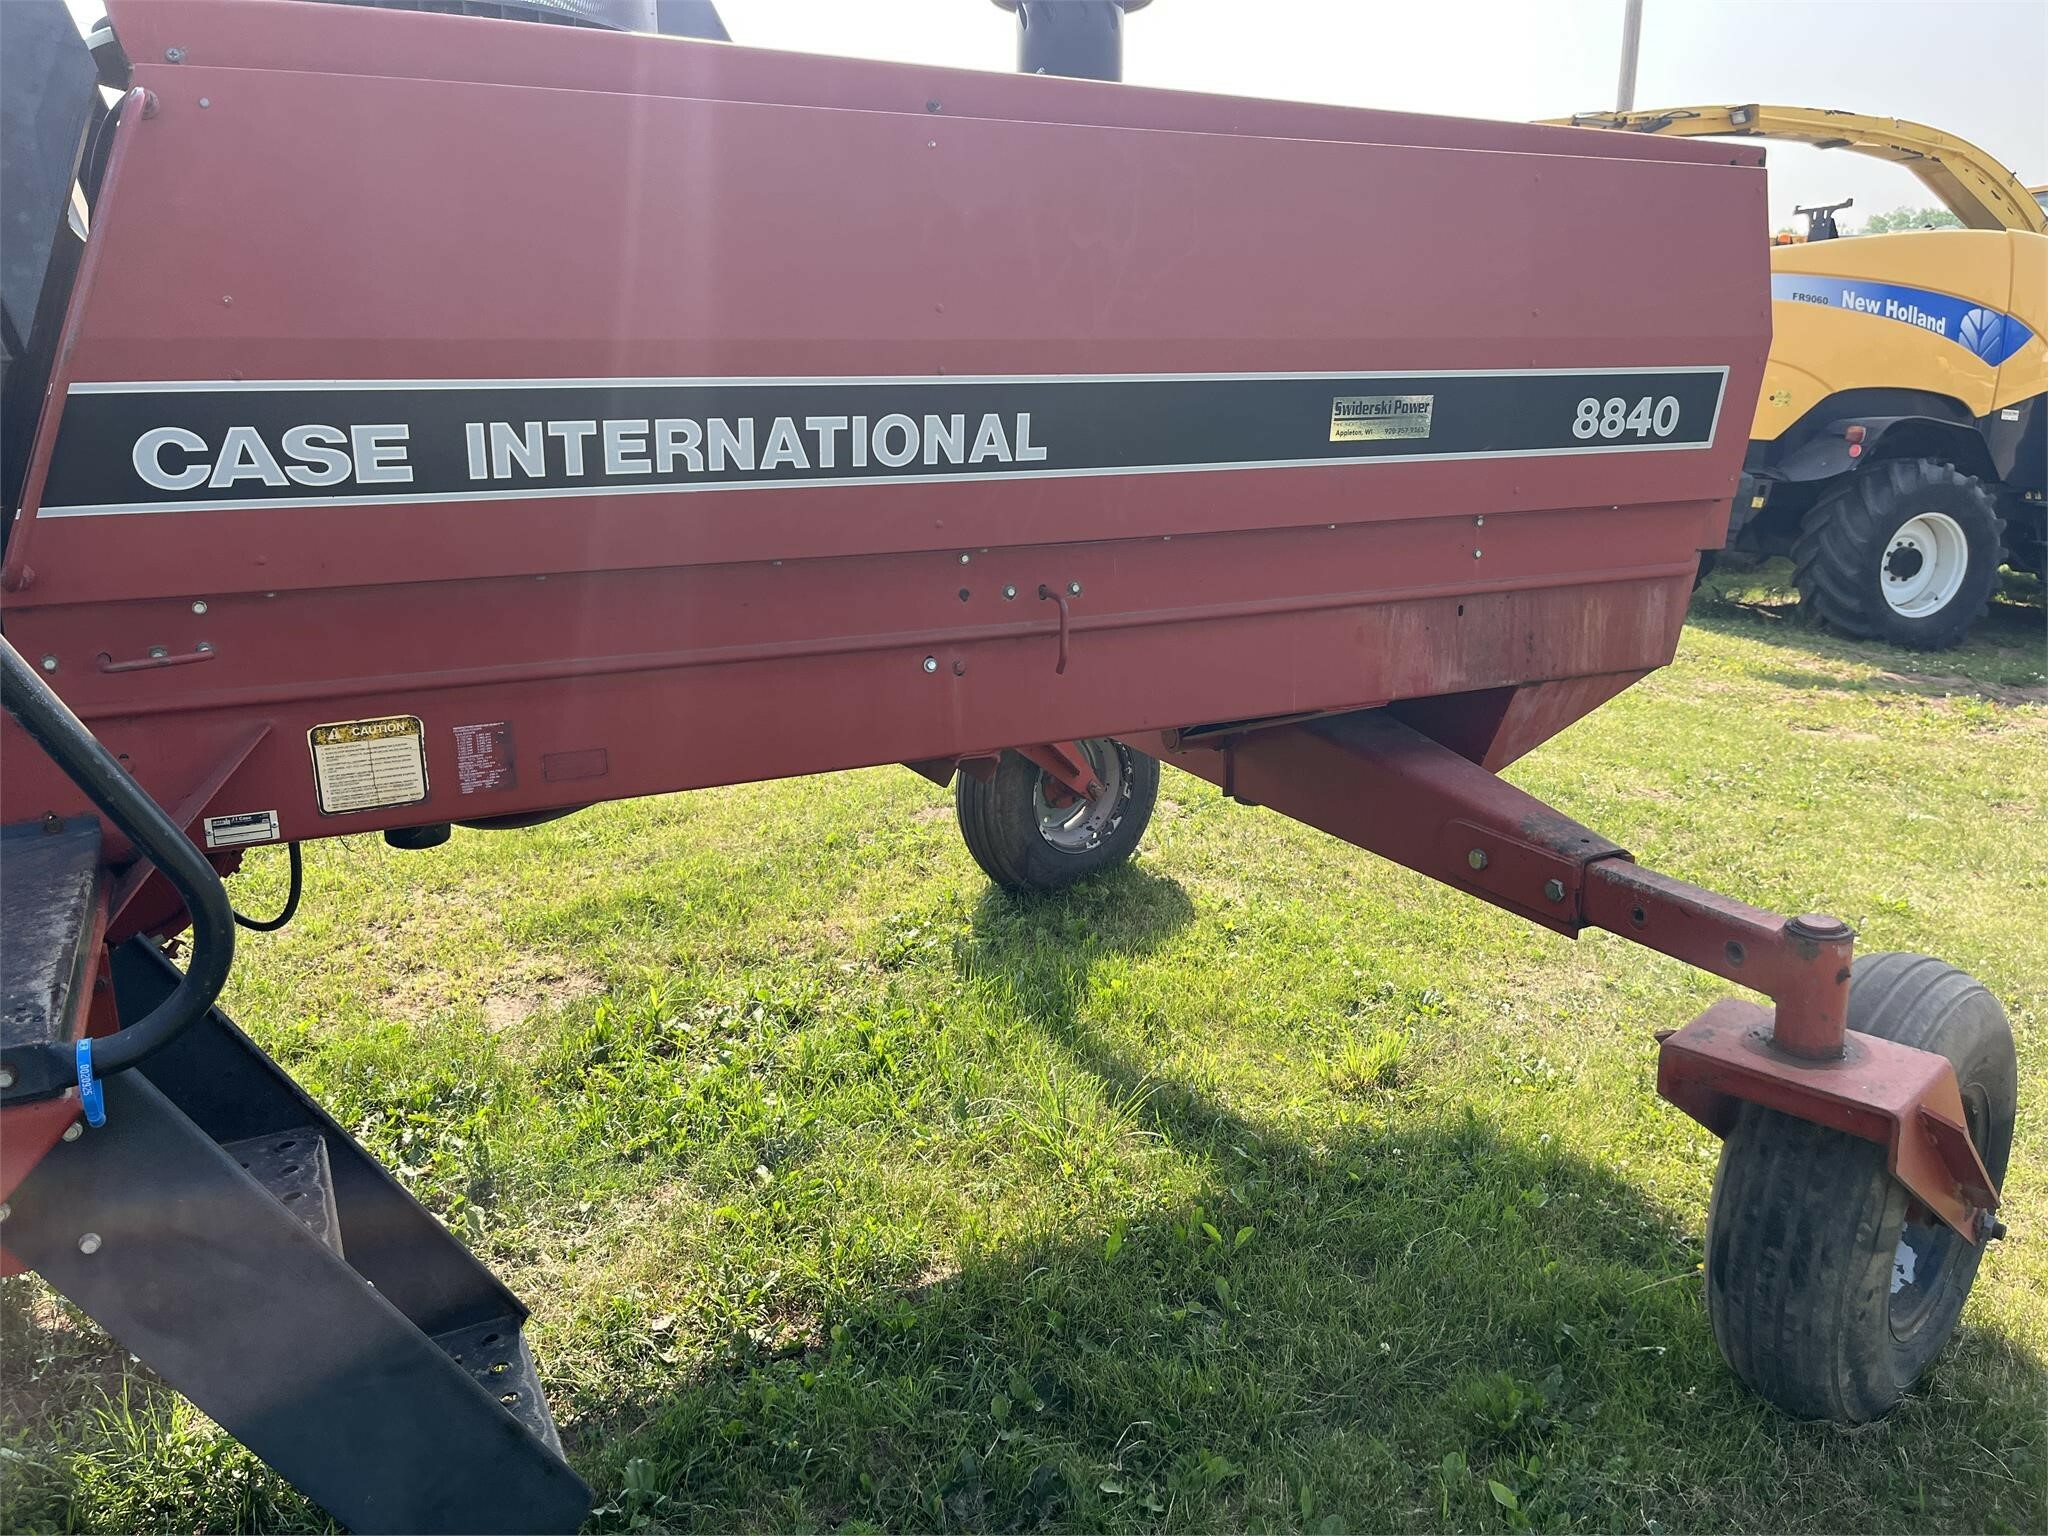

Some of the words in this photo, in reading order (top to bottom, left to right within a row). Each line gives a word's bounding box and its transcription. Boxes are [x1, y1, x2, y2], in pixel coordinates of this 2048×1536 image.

[1792, 291, 1829, 305] FR9060
[1841, 289, 1882, 314] New
[1885, 298, 1946, 336] Holland
[1334, 400, 1392, 416] Swiderski
[1394, 399, 1430, 415] Power
[1572, 395, 1680, 440] 8840
[1335, 429, 1363, 437] Appleton,
[132, 424, 415, 491] CASE
[465, 412, 1048, 480] INTERNATIONAL
[352, 722, 405, 736] CAUTION
[79, 1064, 93, 1096] 0020925
